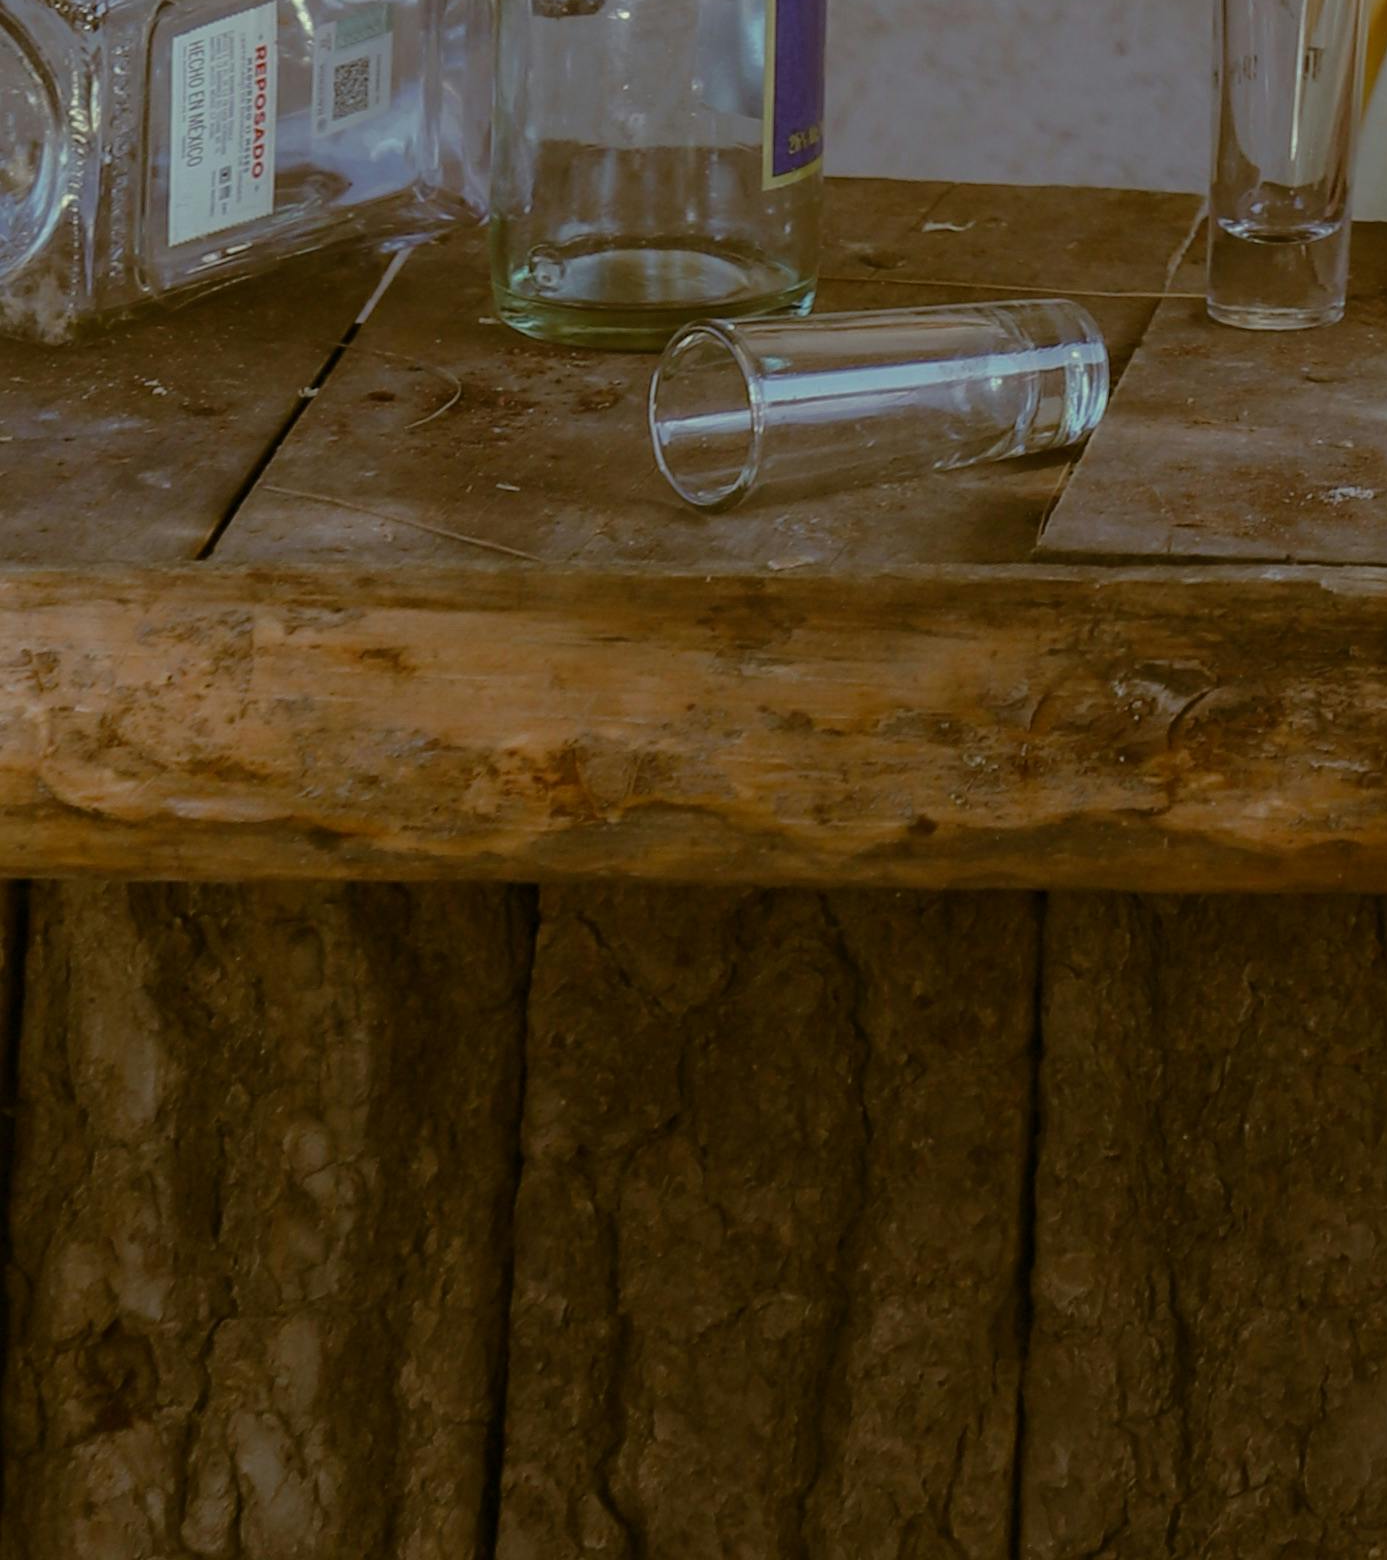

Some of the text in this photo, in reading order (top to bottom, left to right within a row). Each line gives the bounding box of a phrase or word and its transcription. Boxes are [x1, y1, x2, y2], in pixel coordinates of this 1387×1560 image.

[186, 40, 207, 168] HECHO EN MÉXICO
[251, 44, 268, 180] REPOSADO
